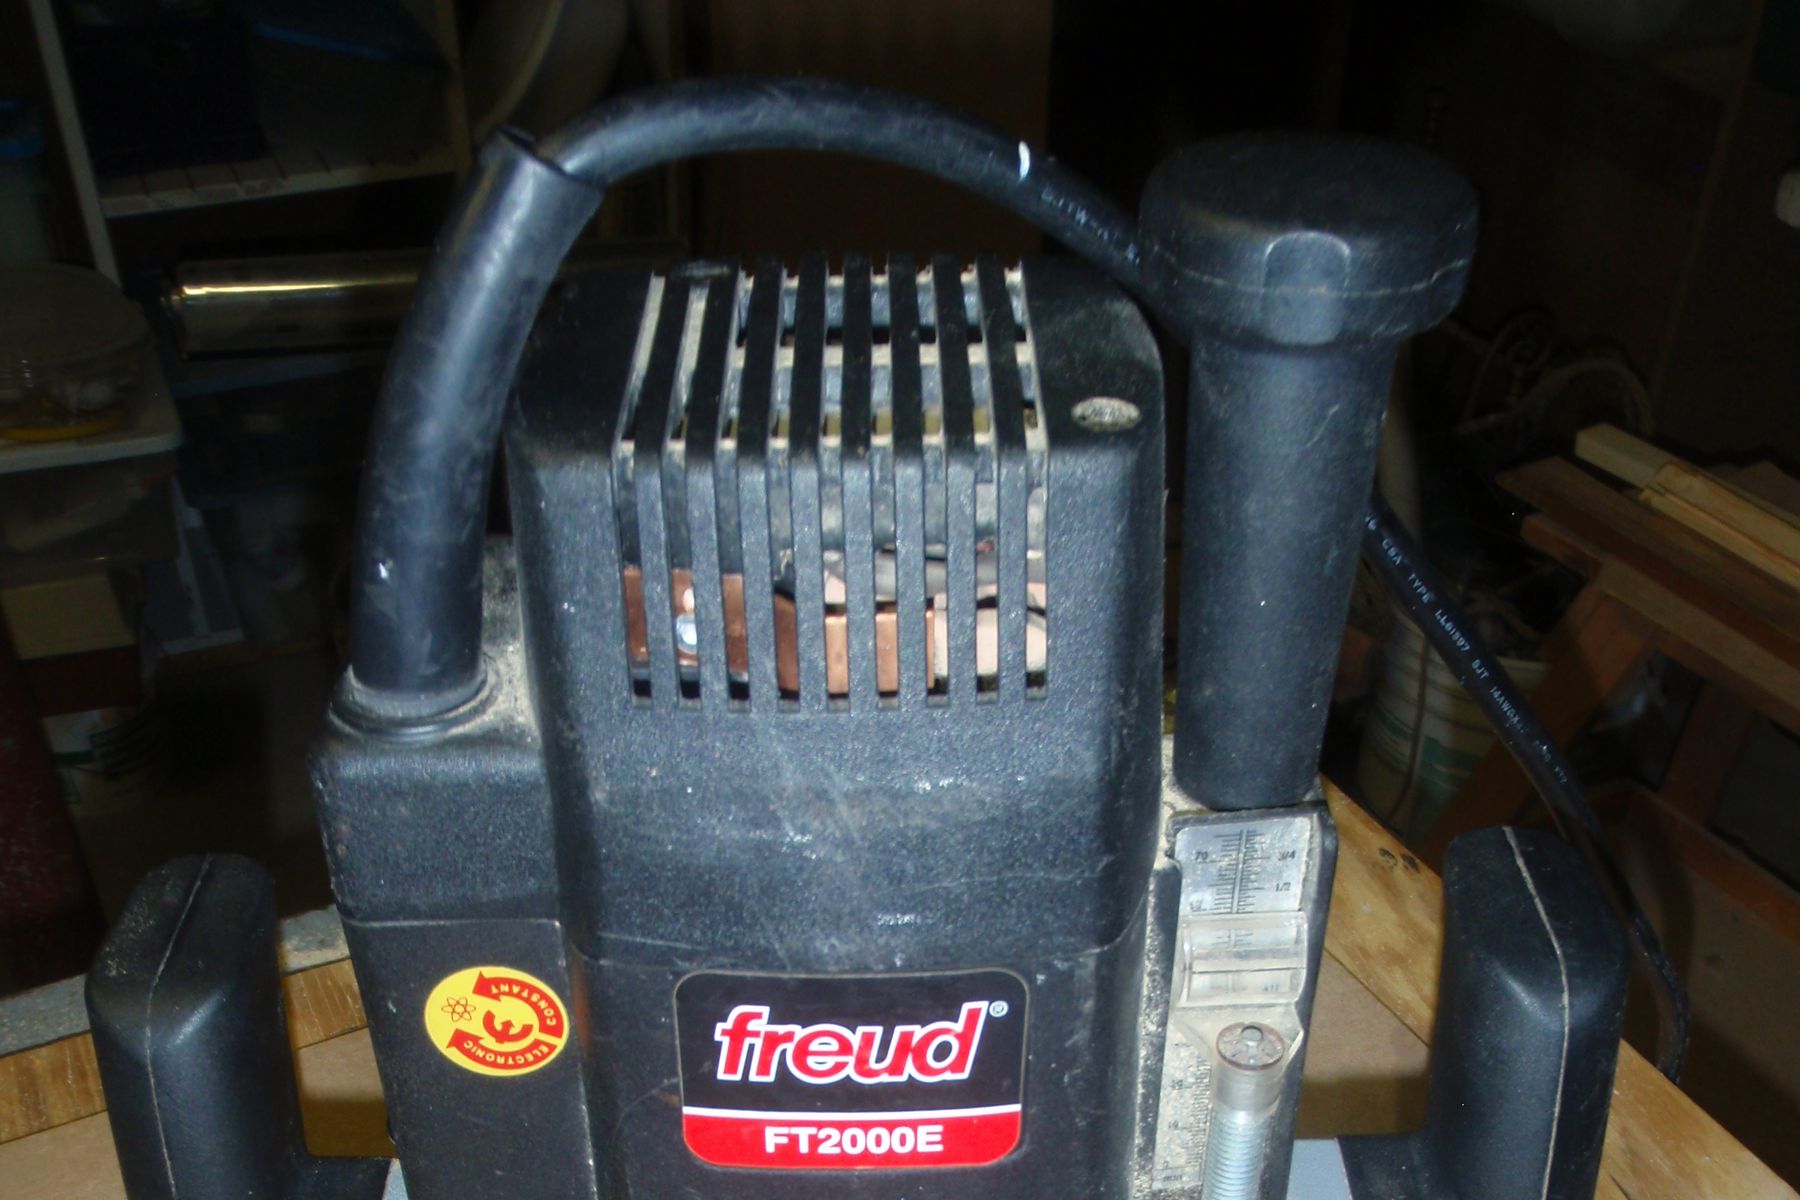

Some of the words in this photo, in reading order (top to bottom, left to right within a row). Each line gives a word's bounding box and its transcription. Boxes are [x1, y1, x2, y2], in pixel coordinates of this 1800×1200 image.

[490, 983, 557, 1026] CONSTANT
[463, 1039, 550, 1065] ELECTRONIC
[714, 1001, 990, 1085] freud
[764, 1125, 944, 1155] FT2000E
